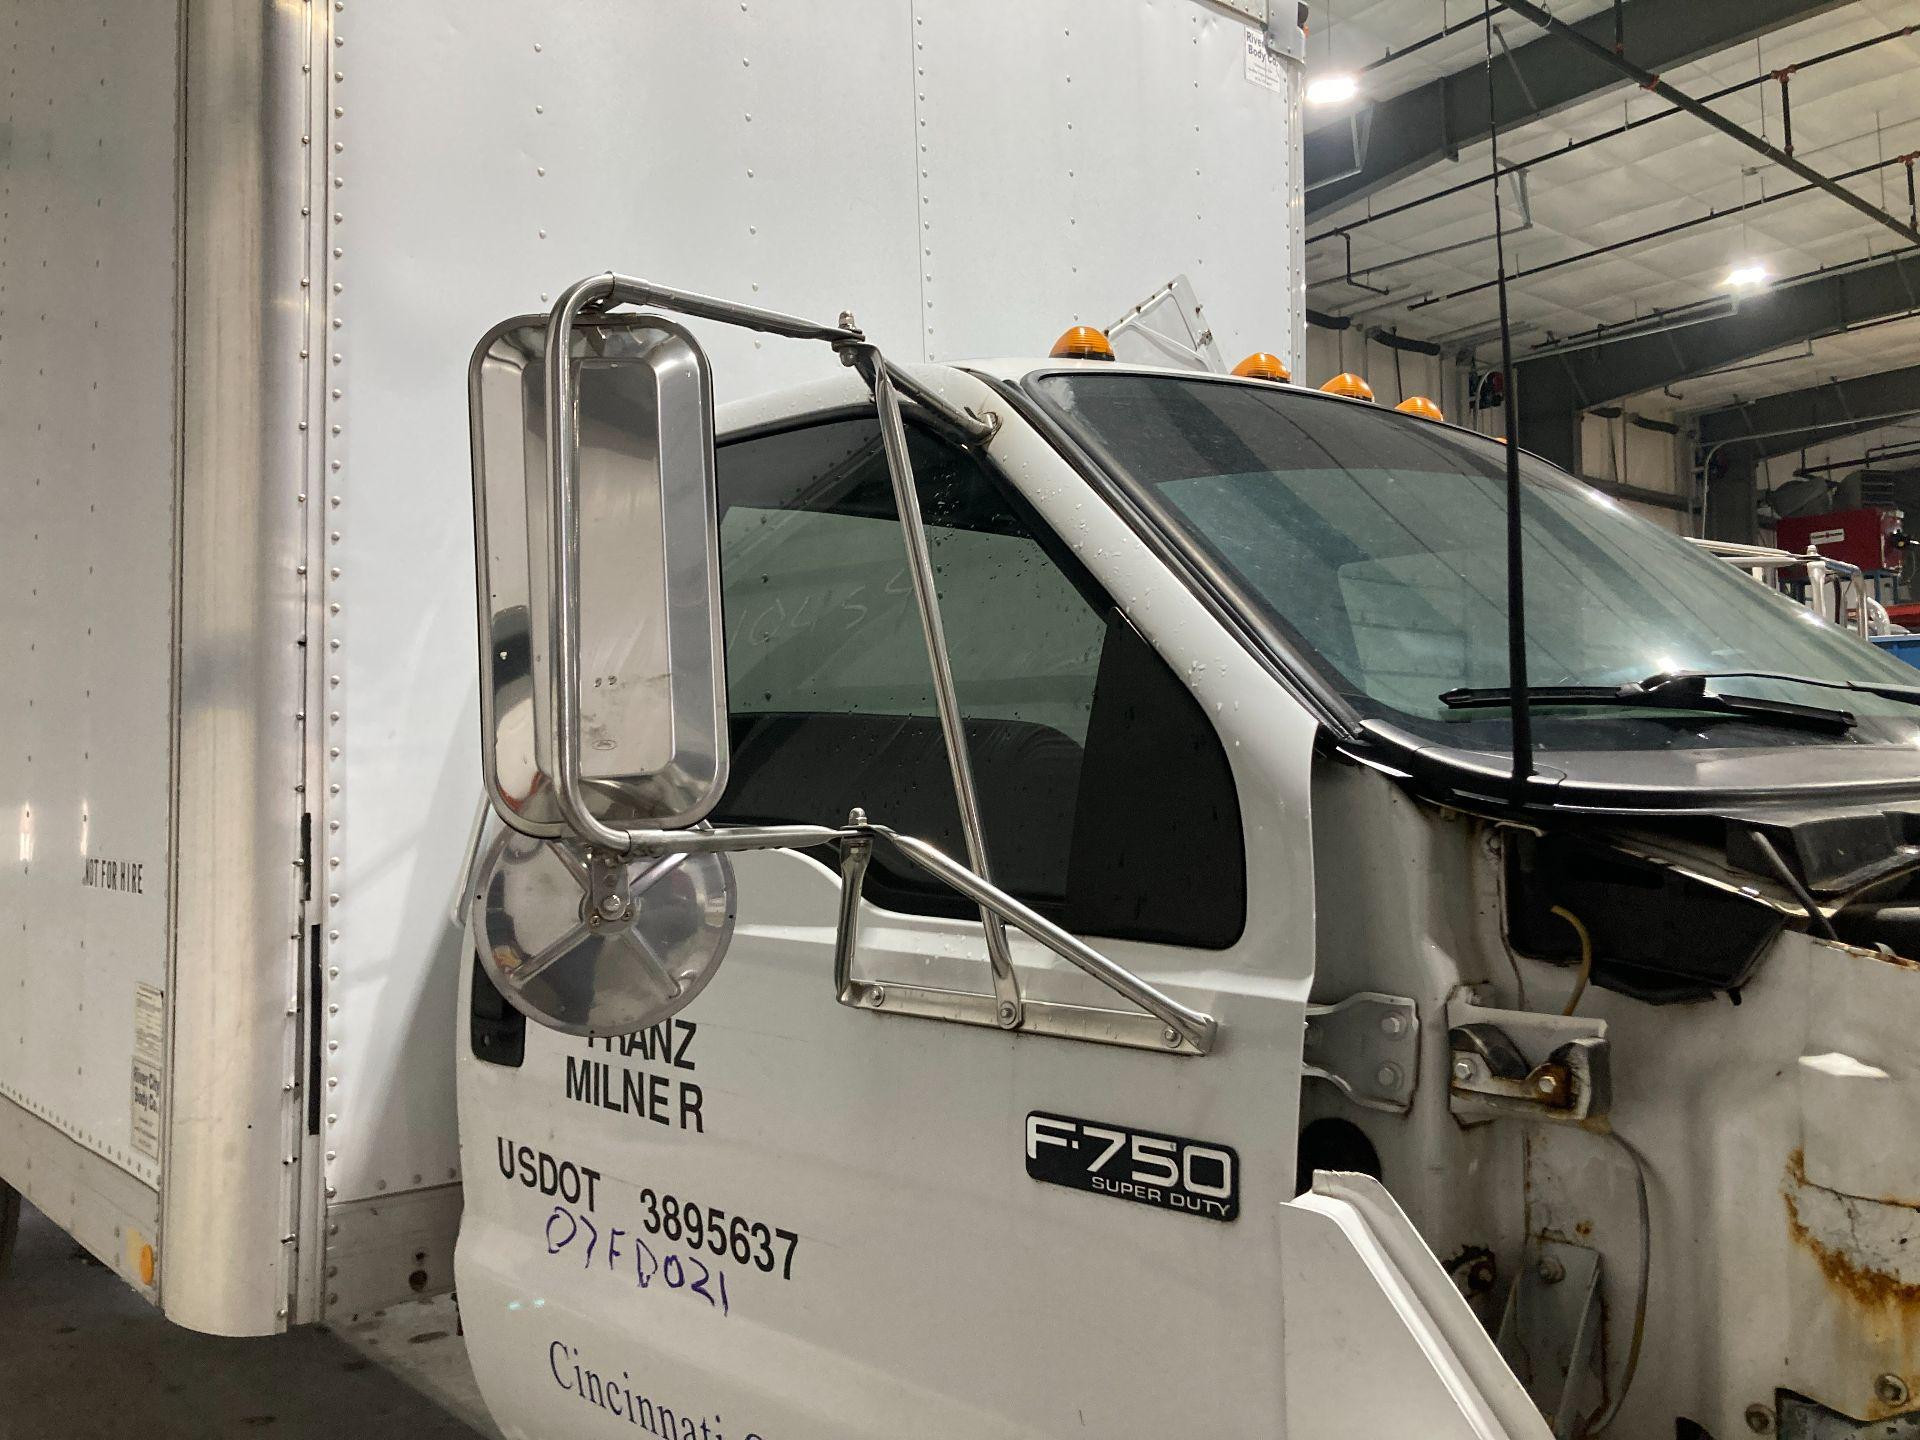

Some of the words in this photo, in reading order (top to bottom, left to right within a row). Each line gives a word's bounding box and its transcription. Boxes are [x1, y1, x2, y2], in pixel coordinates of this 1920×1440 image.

[1248, 44, 1267, 62] Body
[101, 860, 117, 891] FOR
[121, 862, 143, 895] HIRE
[588, 1018, 697, 1071] ANZ
[566, 1056, 704, 1133] MILNER
[497, 1136, 601, 1212] USDOT
[640, 1188, 799, 1280] 3895637
[1092, 1176, 1161, 1203] SUPER
[1170, 1192, 1231, 1217] DUTY
